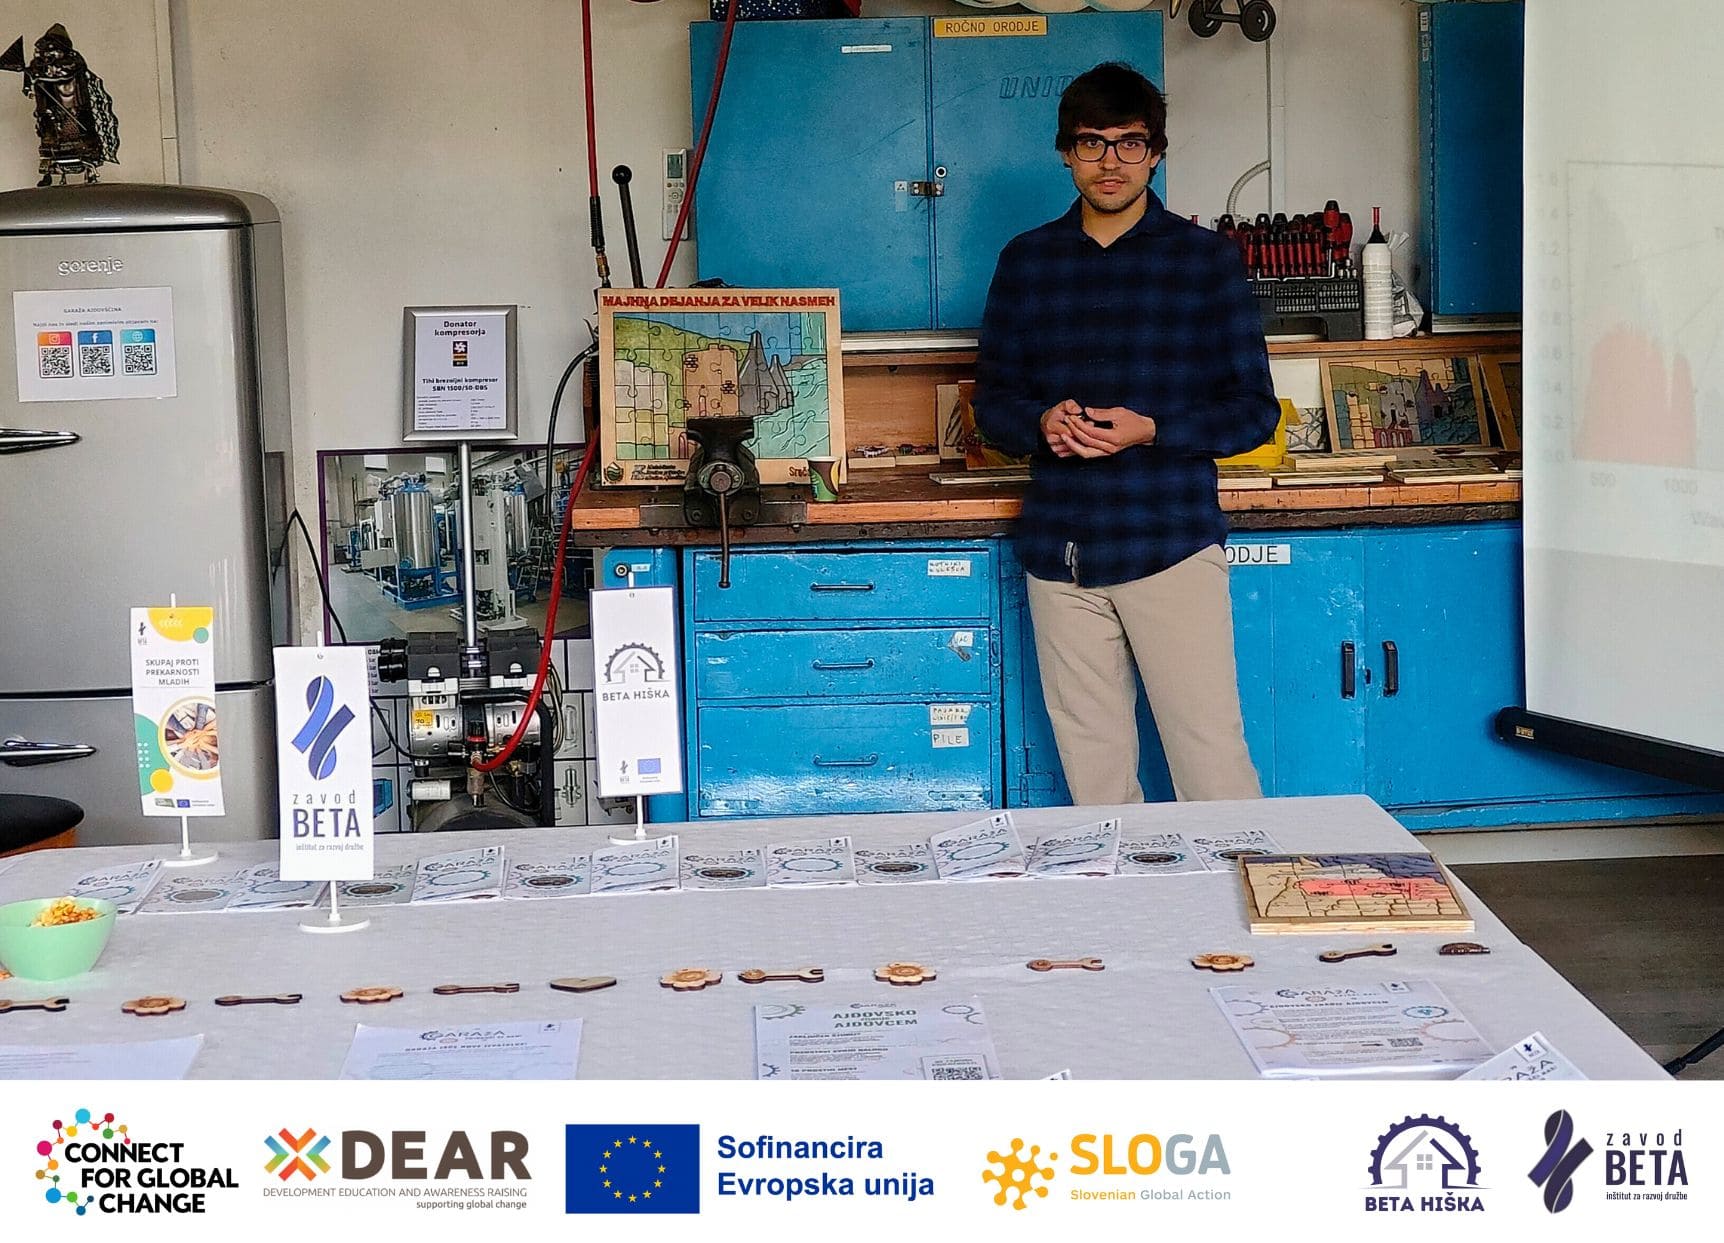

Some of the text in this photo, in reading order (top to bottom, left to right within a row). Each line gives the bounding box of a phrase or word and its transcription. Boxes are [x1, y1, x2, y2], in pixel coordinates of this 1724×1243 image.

[945, 19, 1039, 34] ROČNO ORODJE
[57, 256, 123, 275] gorenje
[660, 296, 721, 307] DEJANJA
[722, 296, 739, 307] ZA
[742, 296, 779, 307] VELIK
[780, 295, 835, 306] NASMEH
[443, 320, 477, 328] Donator
[434, 329, 486, 337] kompresorja
[145, 659, 174, 667] SKUPAJ
[145, 668, 199, 676] PREKARNOSTI
[158, 678, 190, 686] MLADIH
[602, 687, 670, 702] BETA HIŠKA
[933, 733, 962, 745] PILE
[293, 789, 356, 805] zavod
[292, 808, 361, 838] BETA
[832, 1009, 917, 1020] AJDOVSKO
[834, 1019, 918, 1028] AJDOVCEM
